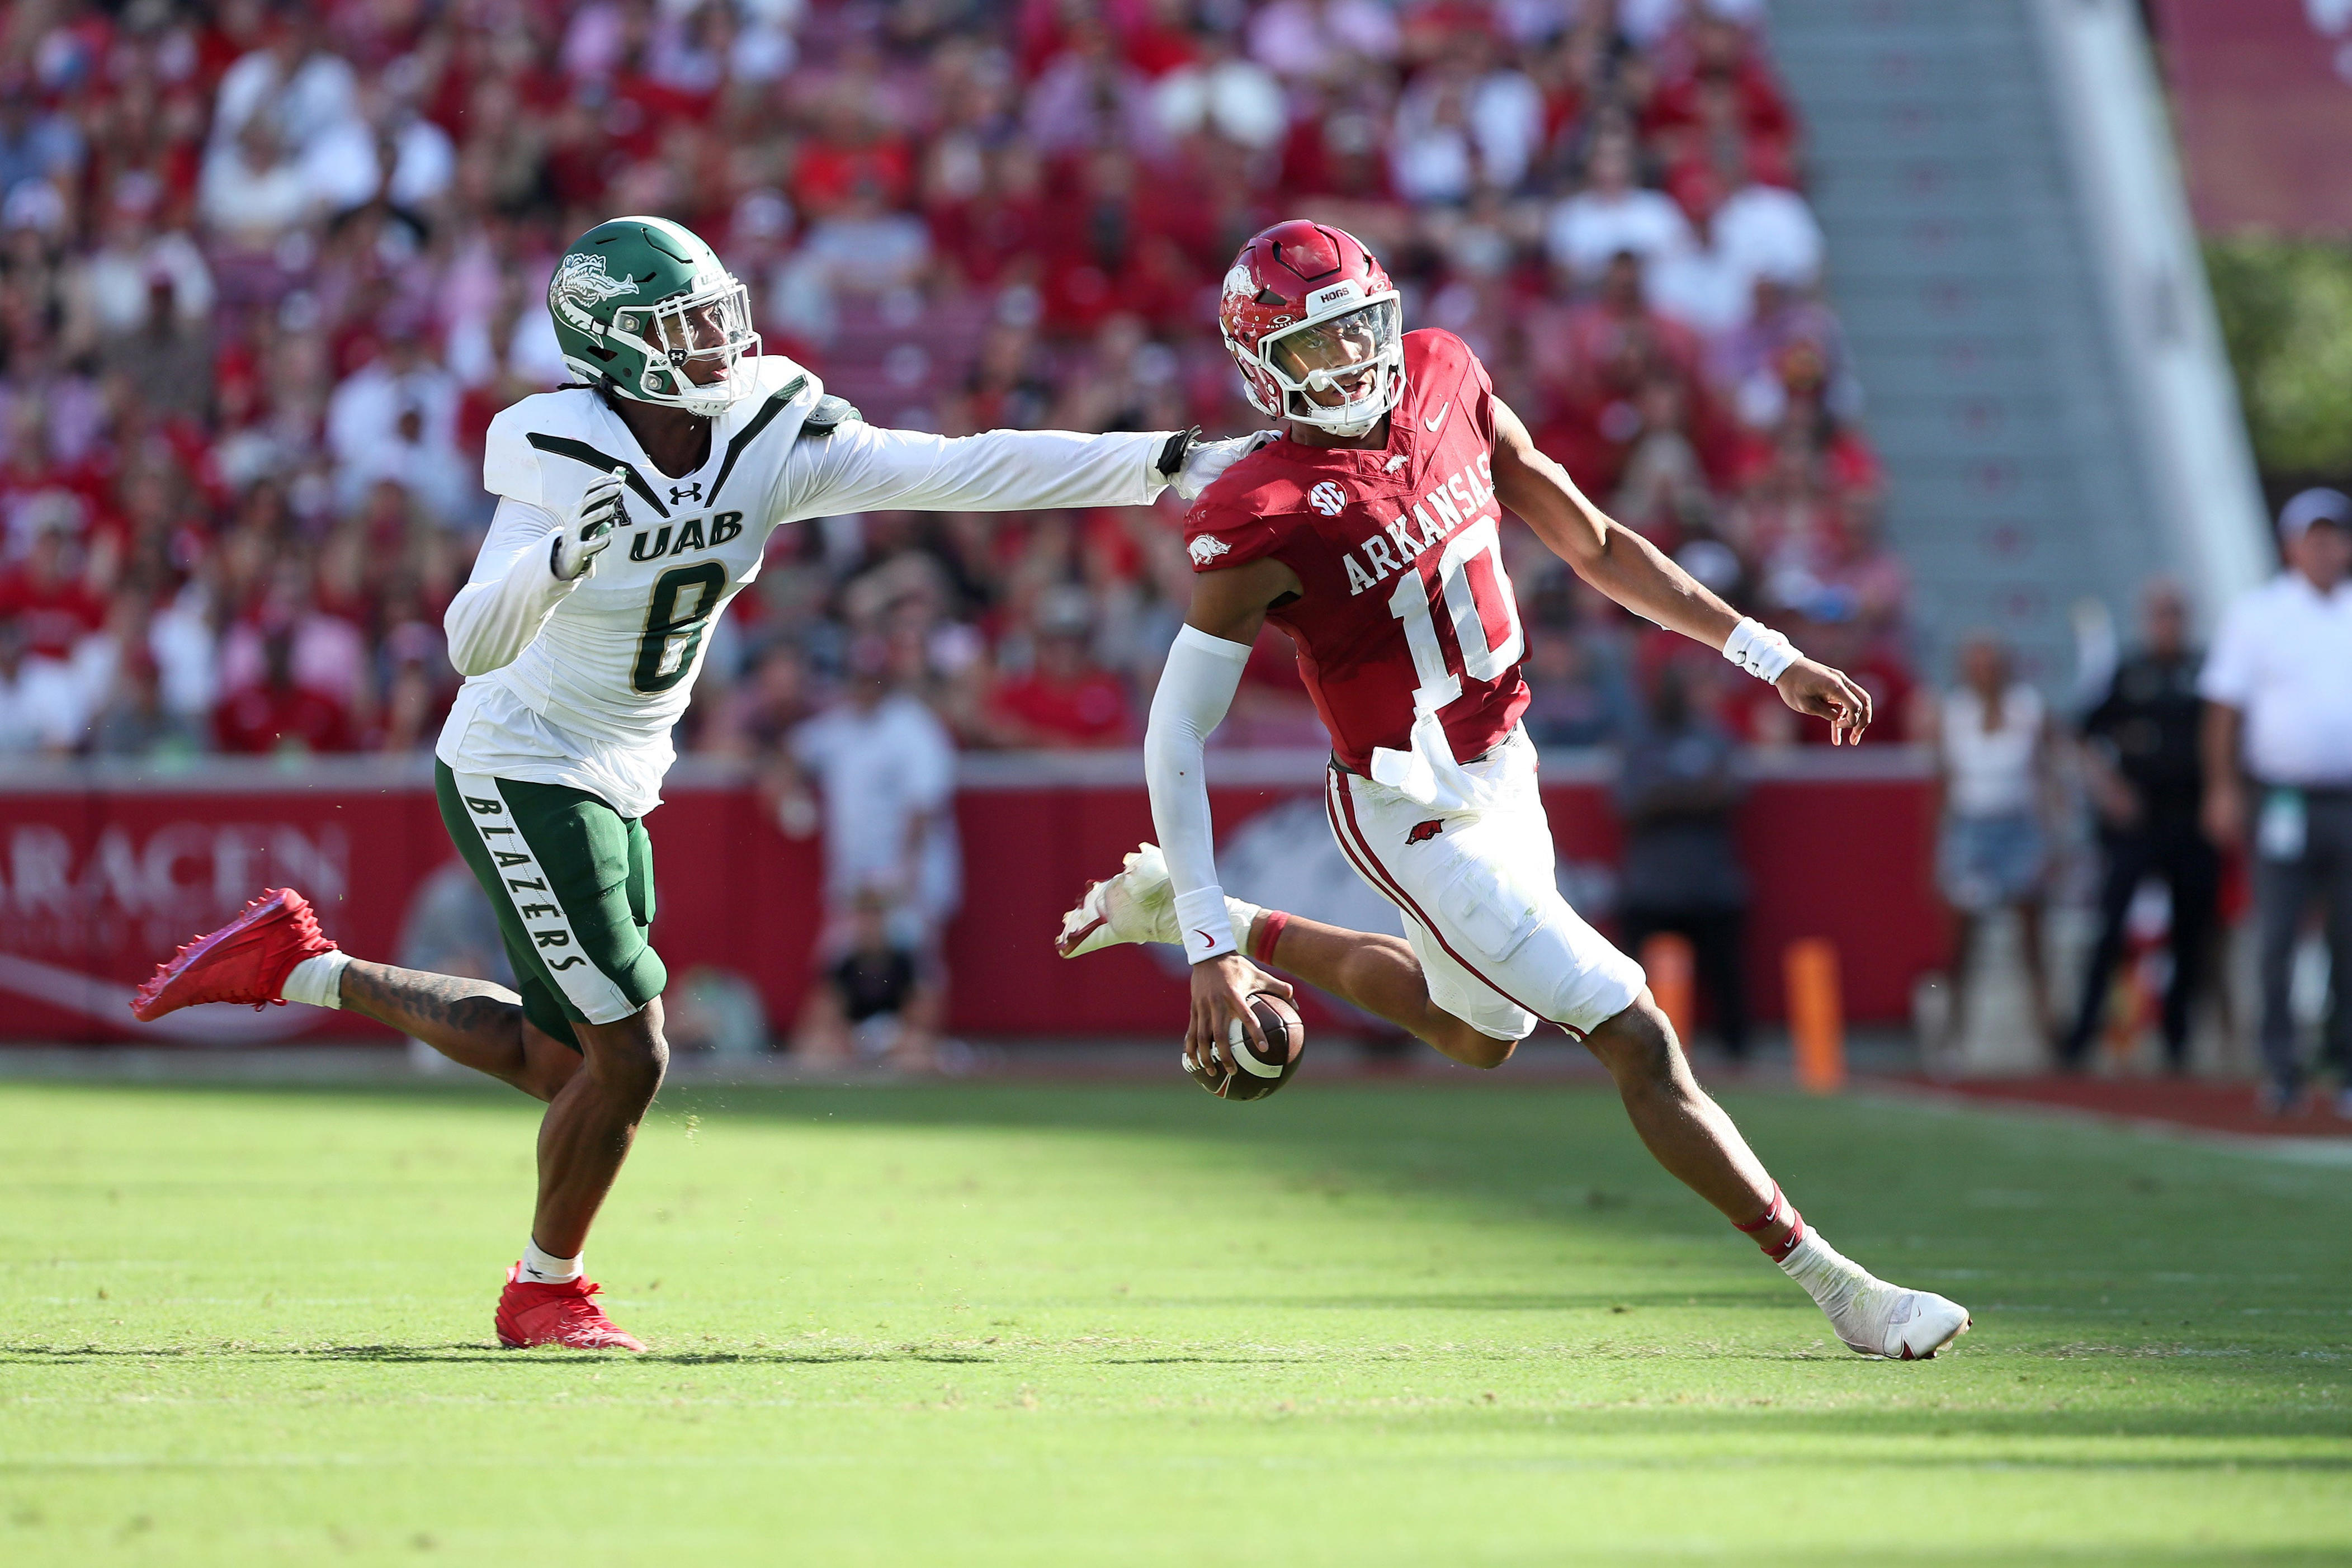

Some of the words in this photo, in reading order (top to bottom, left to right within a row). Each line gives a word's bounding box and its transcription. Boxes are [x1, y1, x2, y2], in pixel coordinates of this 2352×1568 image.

[1320, 287, 1349, 303] HOGS
[630, 509, 743, 563] UAB
[1311, 481, 1345, 516] SEC
[1343, 450, 1493, 596] ARKANSAS
[629, 559, 729, 698] 8
[1388, 514, 1526, 711] 10
[0, 821, 352, 917] RACEN
[464, 795, 588, 971] BLAZERS
